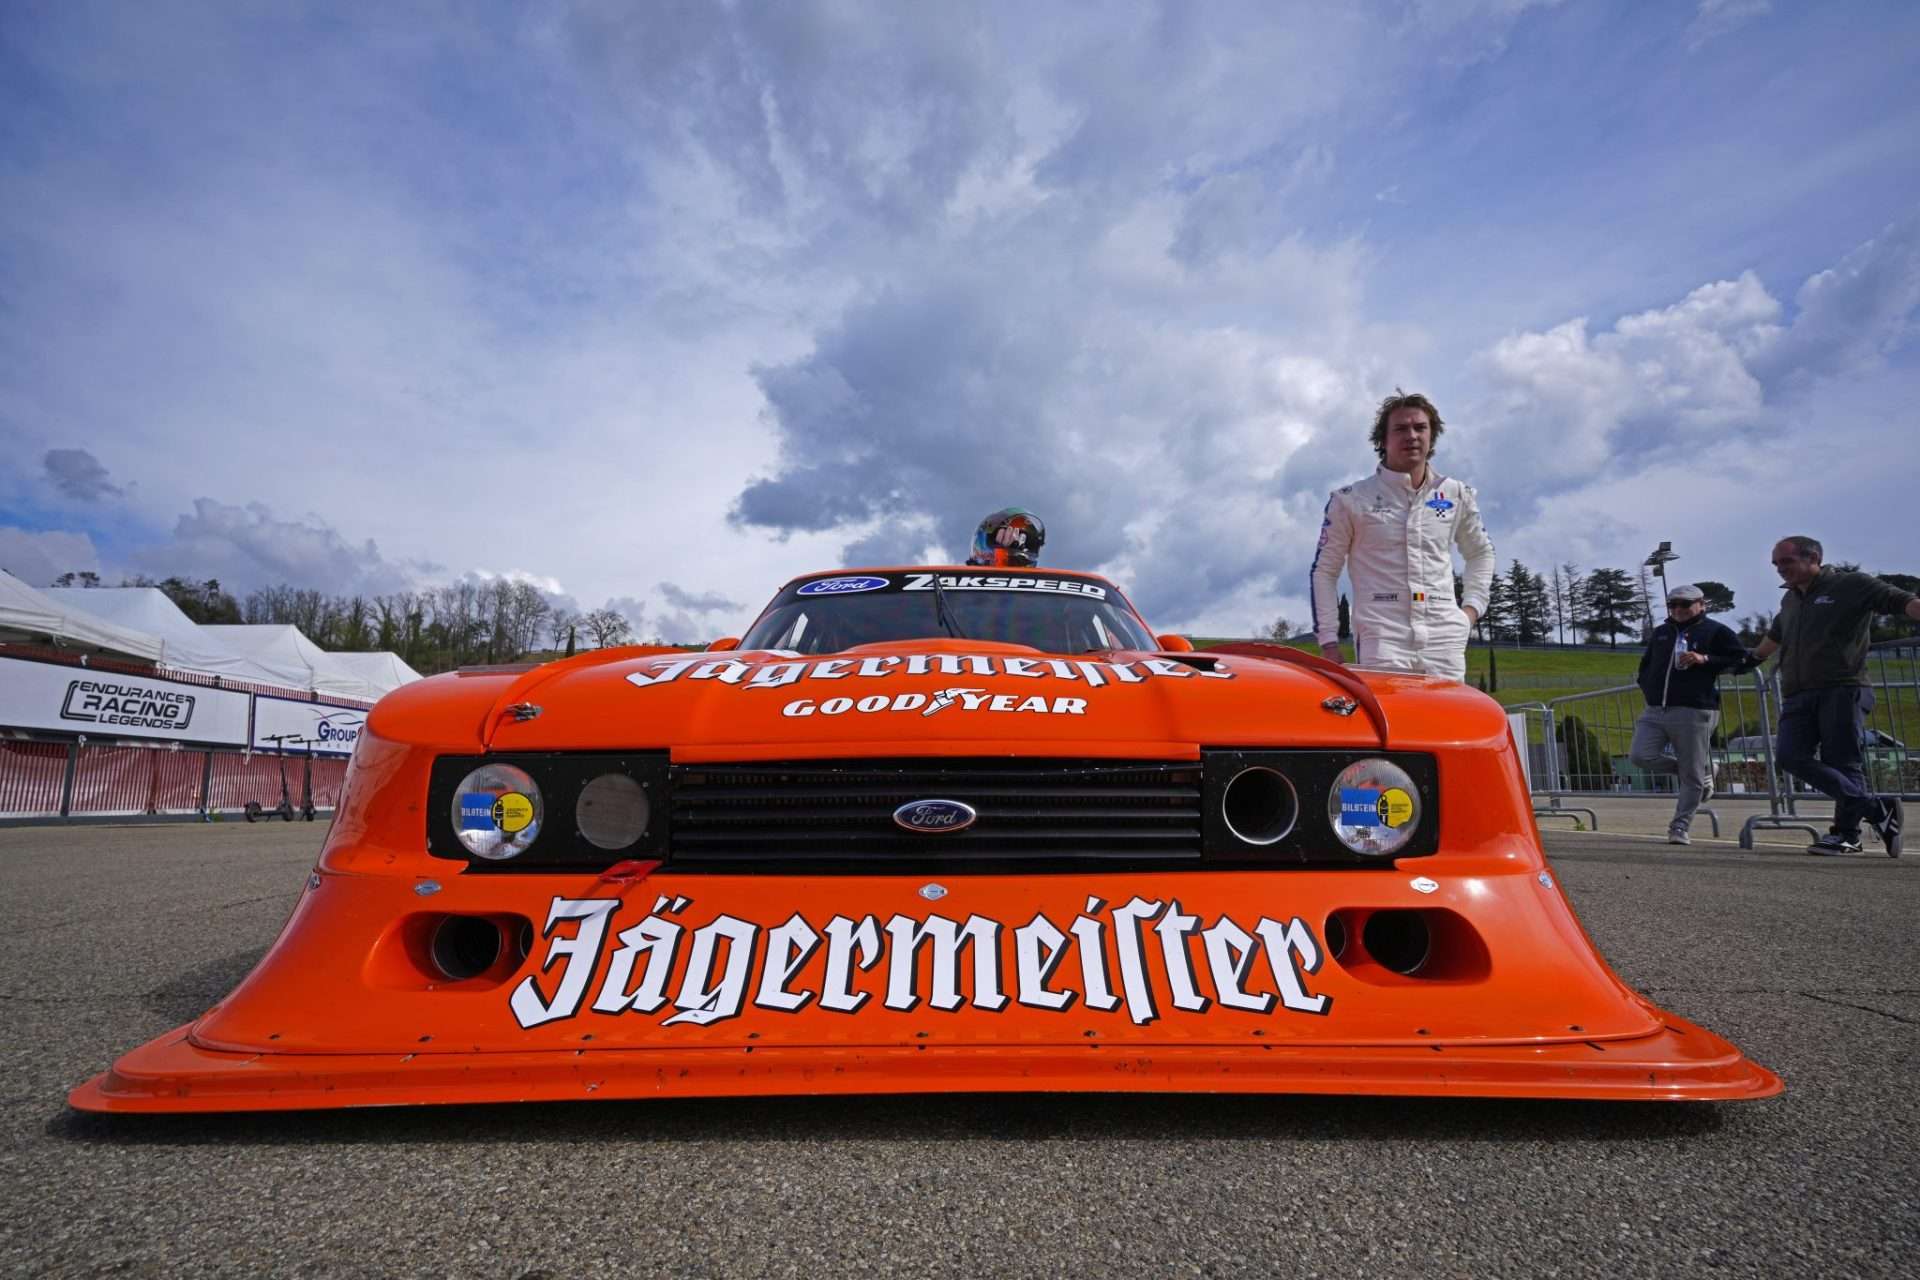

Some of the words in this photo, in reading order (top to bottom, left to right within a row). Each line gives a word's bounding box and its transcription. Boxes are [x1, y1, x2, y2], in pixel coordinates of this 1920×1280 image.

[813, 579, 871, 592] Ford
[902, 573, 1106, 599] ZAKSPEED
[80, 681, 185, 704] ENDURANCE
[82, 694, 180, 718] RACING
[98, 713, 173, 729] LEGENDS
[911, 805, 958, 825] Ford
[1341, 803, 1376, 812] BILSTEIN
